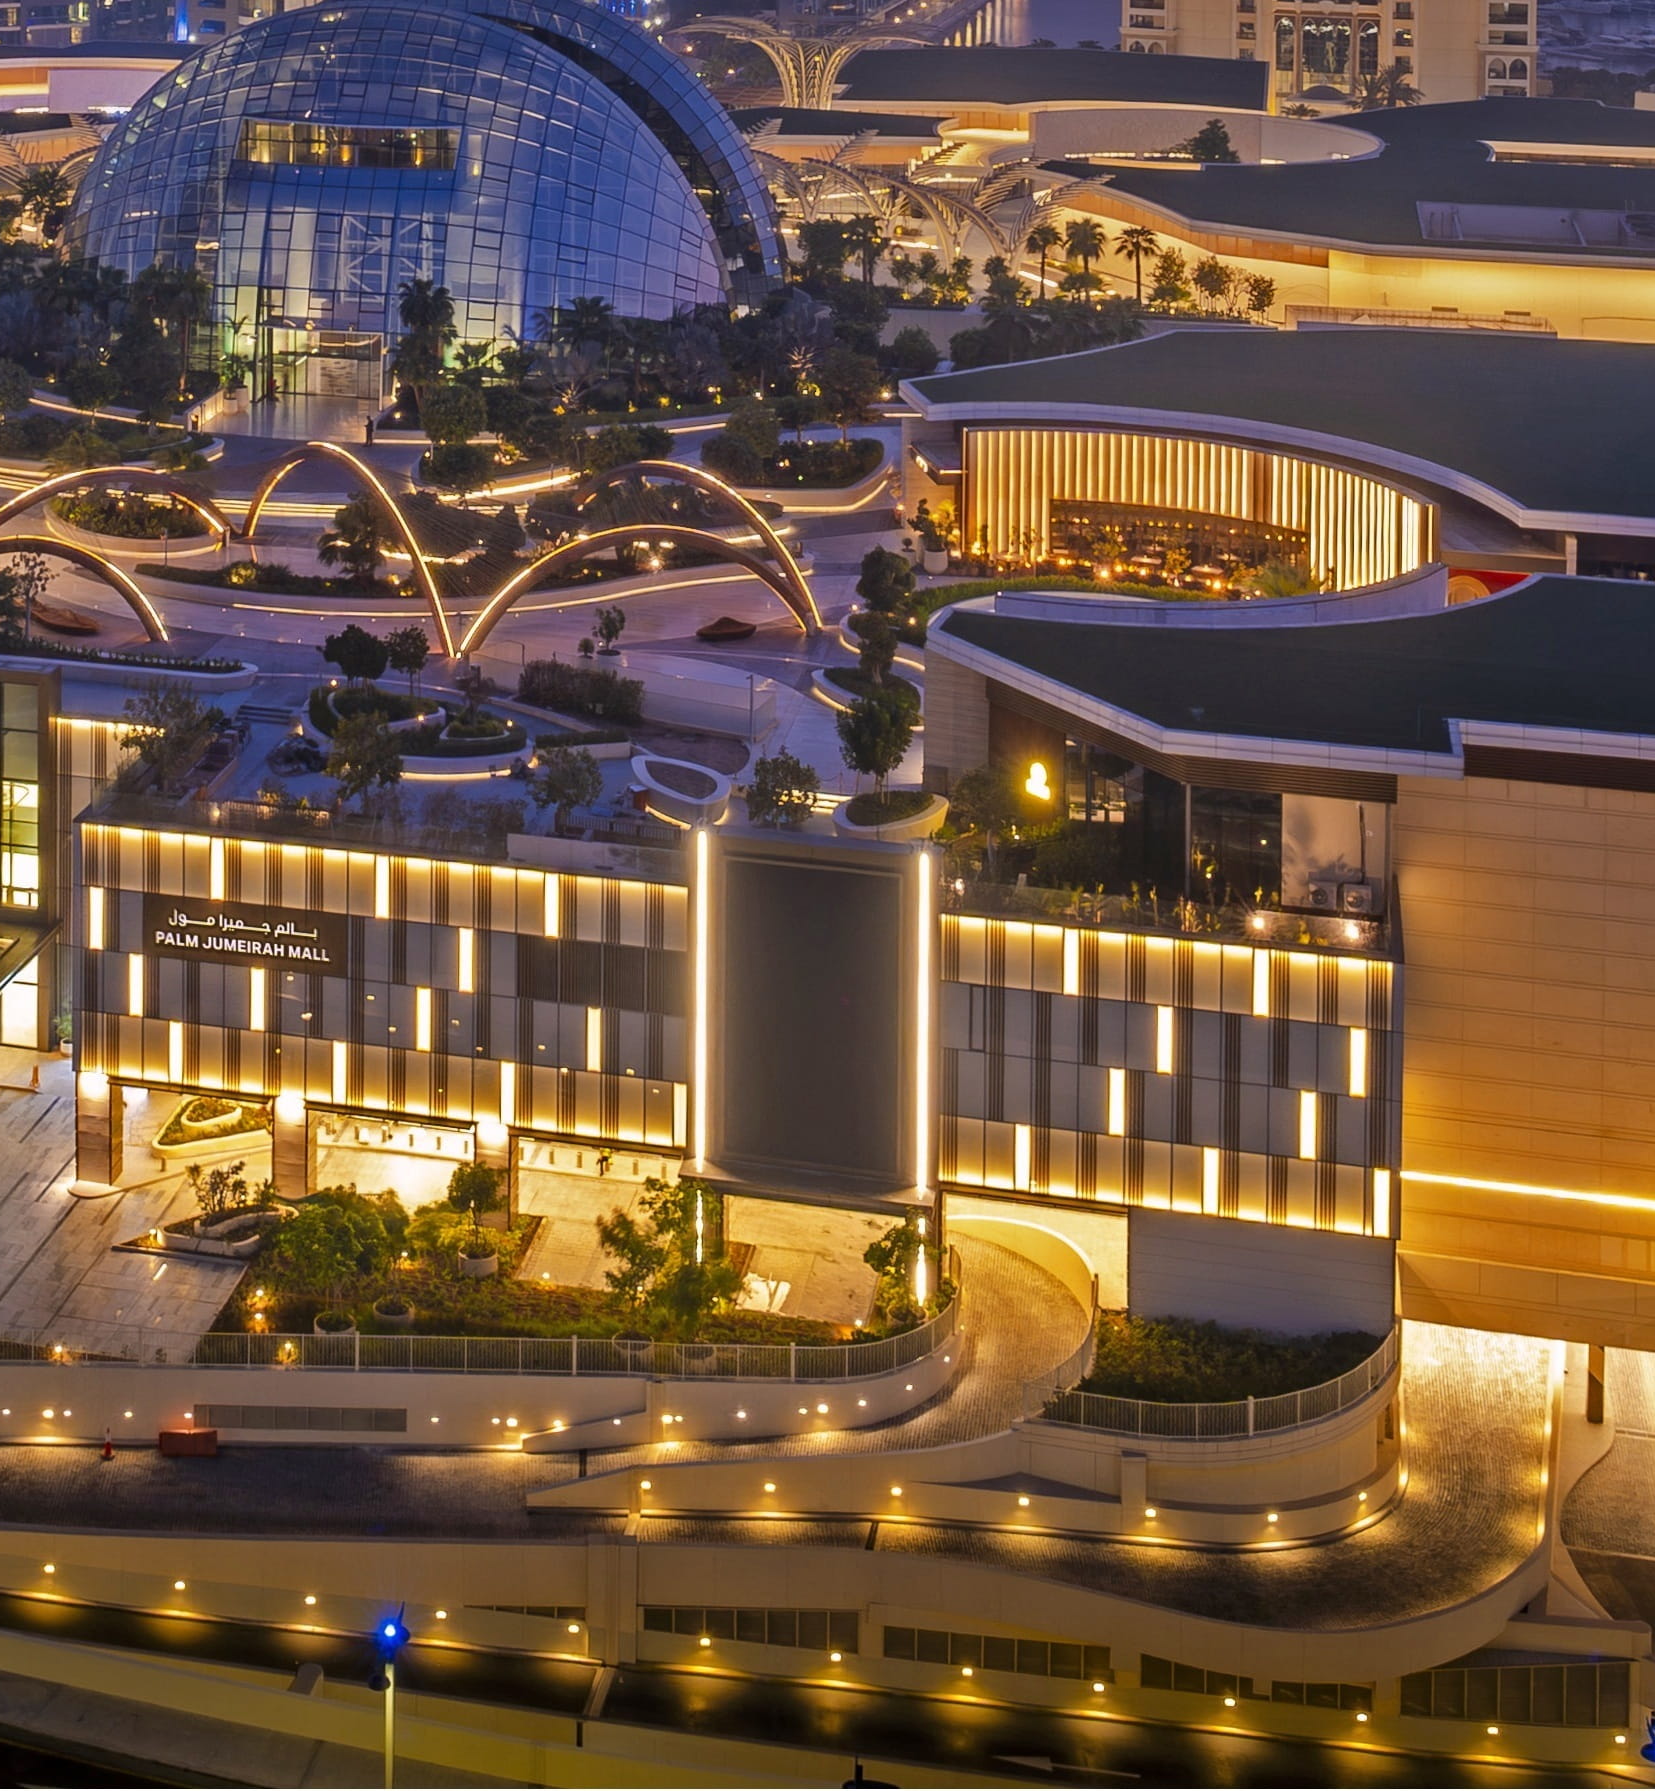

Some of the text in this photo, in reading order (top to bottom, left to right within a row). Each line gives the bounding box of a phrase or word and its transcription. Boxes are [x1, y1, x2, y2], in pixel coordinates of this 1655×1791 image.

[168, 909, 318, 940] بالم جميرا مول
[155, 931, 330, 962] PALM JUMEIRAH MALL
